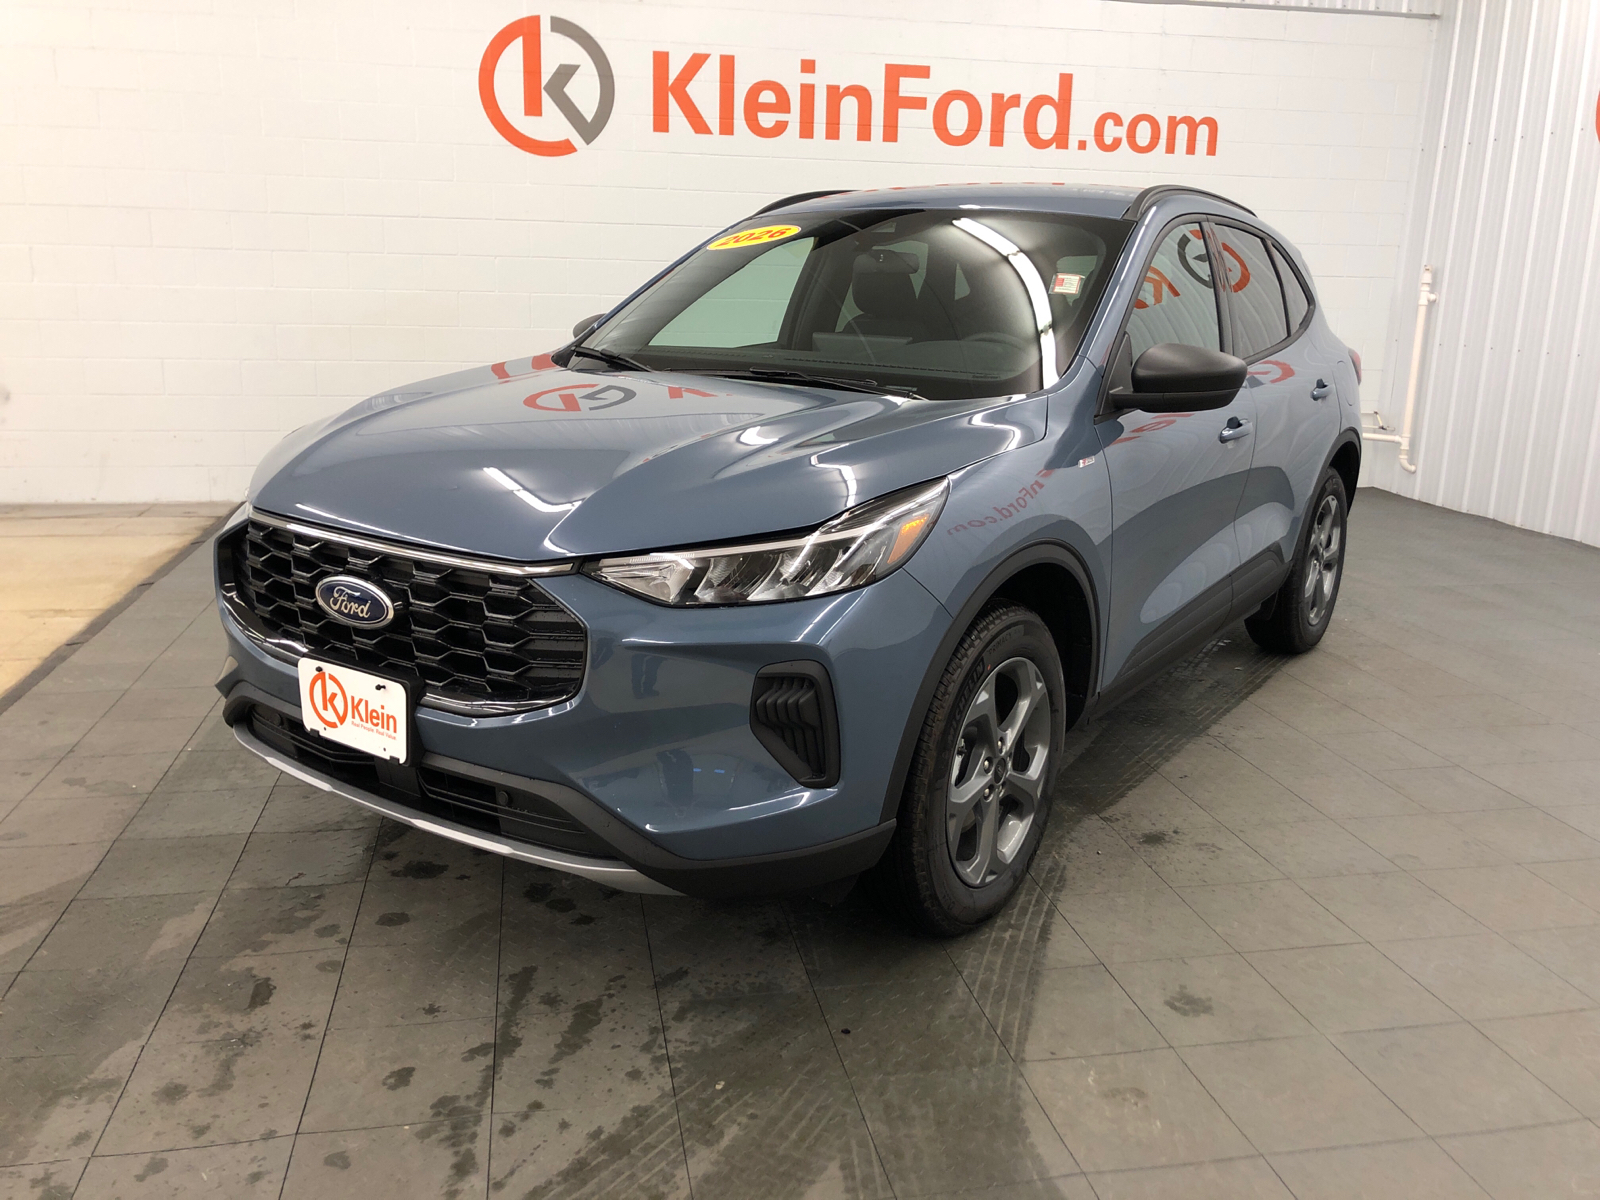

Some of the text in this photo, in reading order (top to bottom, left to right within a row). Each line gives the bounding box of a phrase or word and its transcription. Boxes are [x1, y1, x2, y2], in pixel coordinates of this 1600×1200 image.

[653, 51, 1219, 157] KleinFord.com
[715, 228, 792, 247] 2026
[330, 586, 371, 618] Ford
[351, 695, 397, 734] Klein
